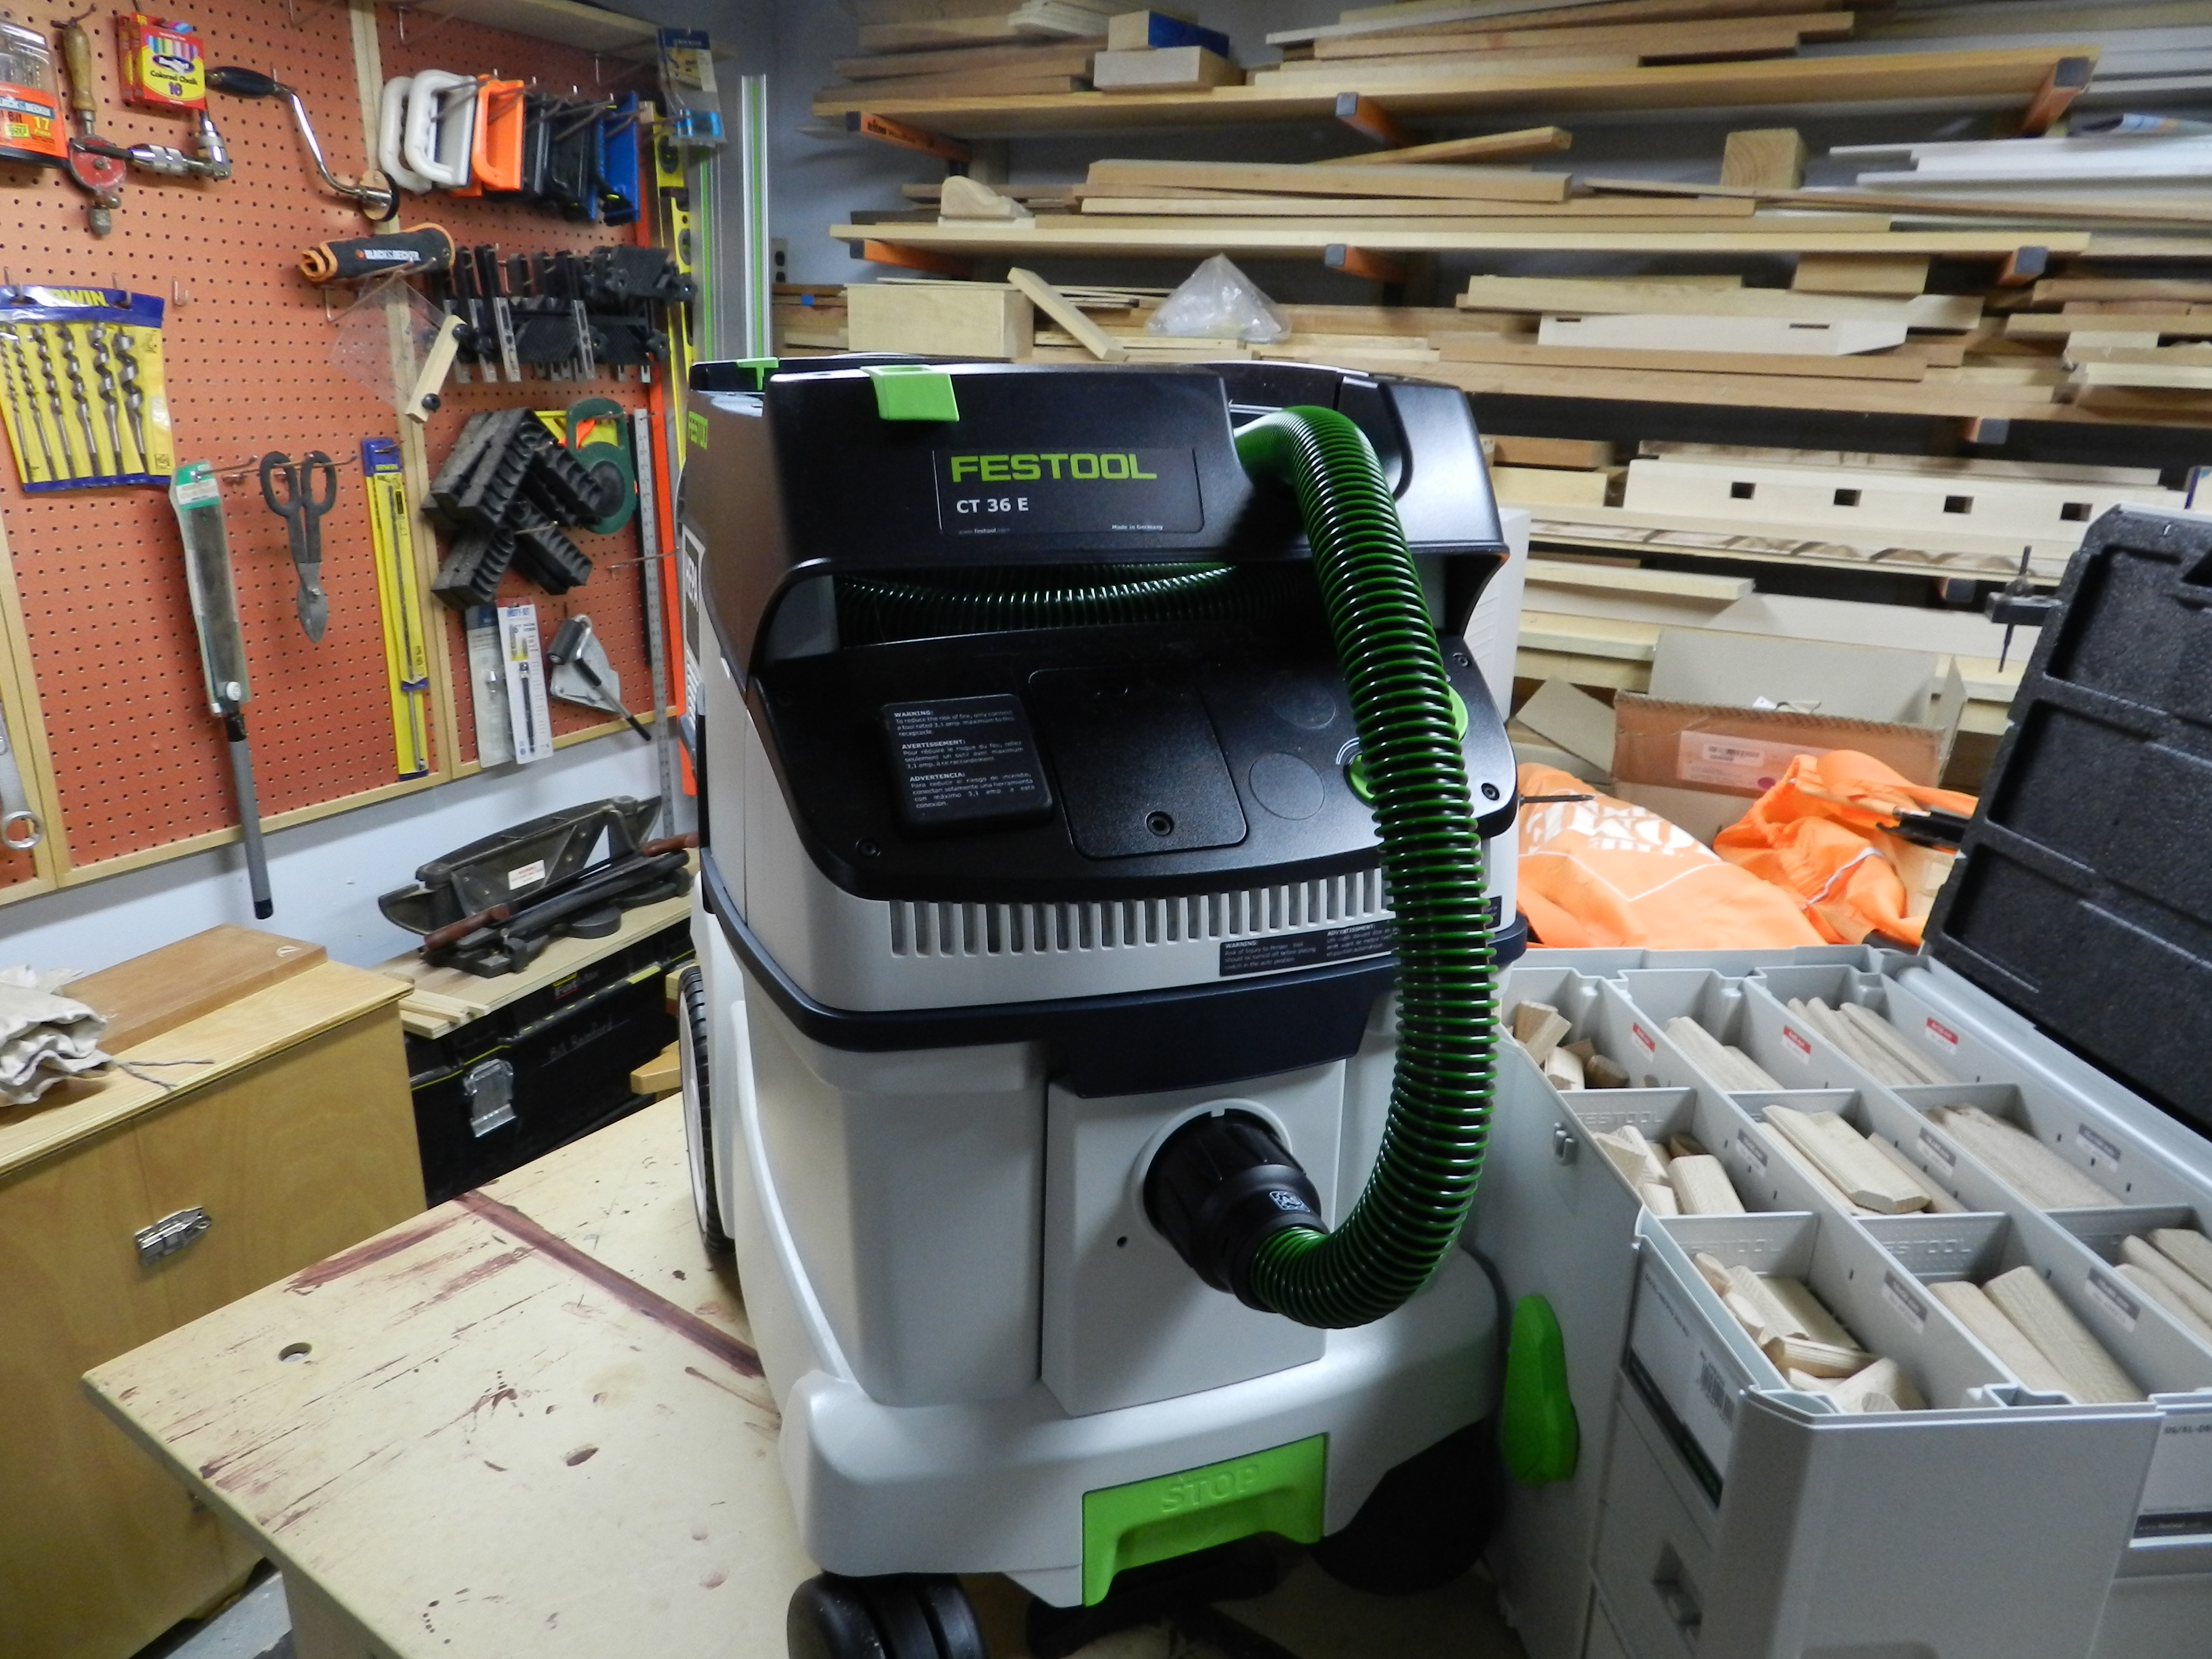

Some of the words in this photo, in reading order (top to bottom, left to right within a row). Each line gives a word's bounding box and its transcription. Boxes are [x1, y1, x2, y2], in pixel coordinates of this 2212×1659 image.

[150, 70, 178, 81] Colored
[179, 75, 198, 85] Chalk
[34, 116, 50, 131] 17
[951, 453, 1157, 483] FESTOOL
[956, 499, 980, 514] CT
[987, 498, 1011, 513] 36
[1018, 497, 1029, 512] E
[1136, 523, 1163, 532] Germany
[902, 739, 966, 749] AVERTISSEMENT:
[910, 772, 965, 782] ADVERTENCIA:
[1161, 1464, 1260, 1512] STOP
